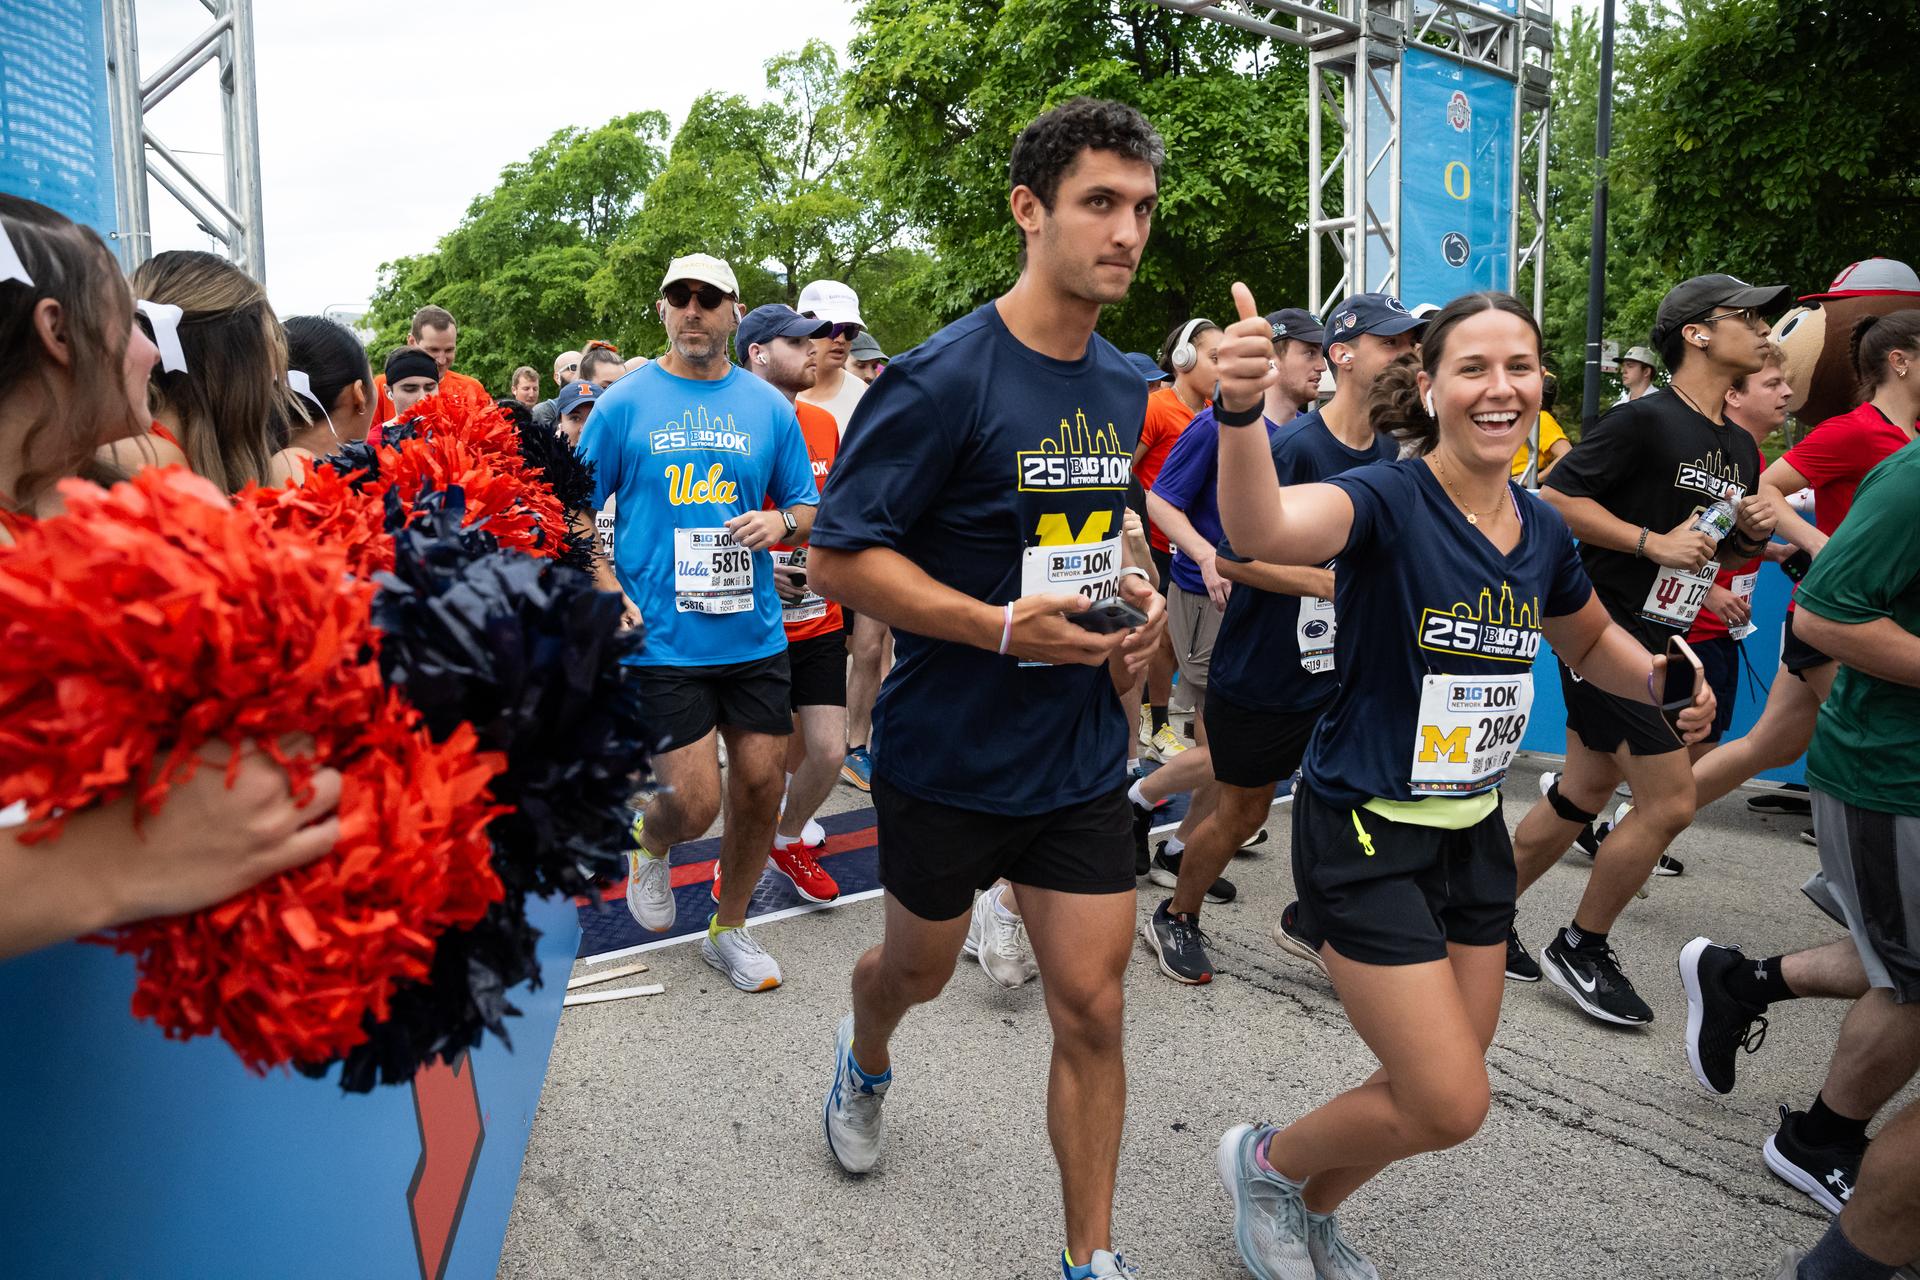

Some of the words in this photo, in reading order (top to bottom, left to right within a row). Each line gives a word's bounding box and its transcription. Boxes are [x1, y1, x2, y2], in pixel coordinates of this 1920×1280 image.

[653, 431, 686, 450] 25
[690, 430, 715, 441] BIG
[714, 431, 748, 452] 10K
[812, 461, 829, 476] 0K
[1023, 457, 1066, 485] 25
[1070, 457, 1100, 476] BIG
[1100, 457, 1131, 485] 10K
[1679, 467, 1707, 489] 25
[1071, 476, 1099, 484] NETWORK
[693, 534, 713, 542] BIG
[714, 533, 737, 547] 10K
[712, 550, 750, 573] 5876
[1052, 555, 1082, 571] BIG
[1082, 549, 1113, 575] 10K
[723, 577, 736, 587] 10K
[745, 575, 751, 586] B
[1052, 570, 1081, 578] NETWORK
[684, 600, 704, 611] 5876
[1423, 616, 1478, 650] 25
[1483, 625, 1519, 647] BIG
[1515, 630, 1542, 658] 10
[1481, 644, 1515, 656] NETWORK
[1452, 687, 1483, 701] BIG
[1483, 685, 1519, 708] 10K
[1475, 714, 1526, 752] 2848
[1418, 725, 1472, 764] M
[1501, 751, 1511, 766] B
